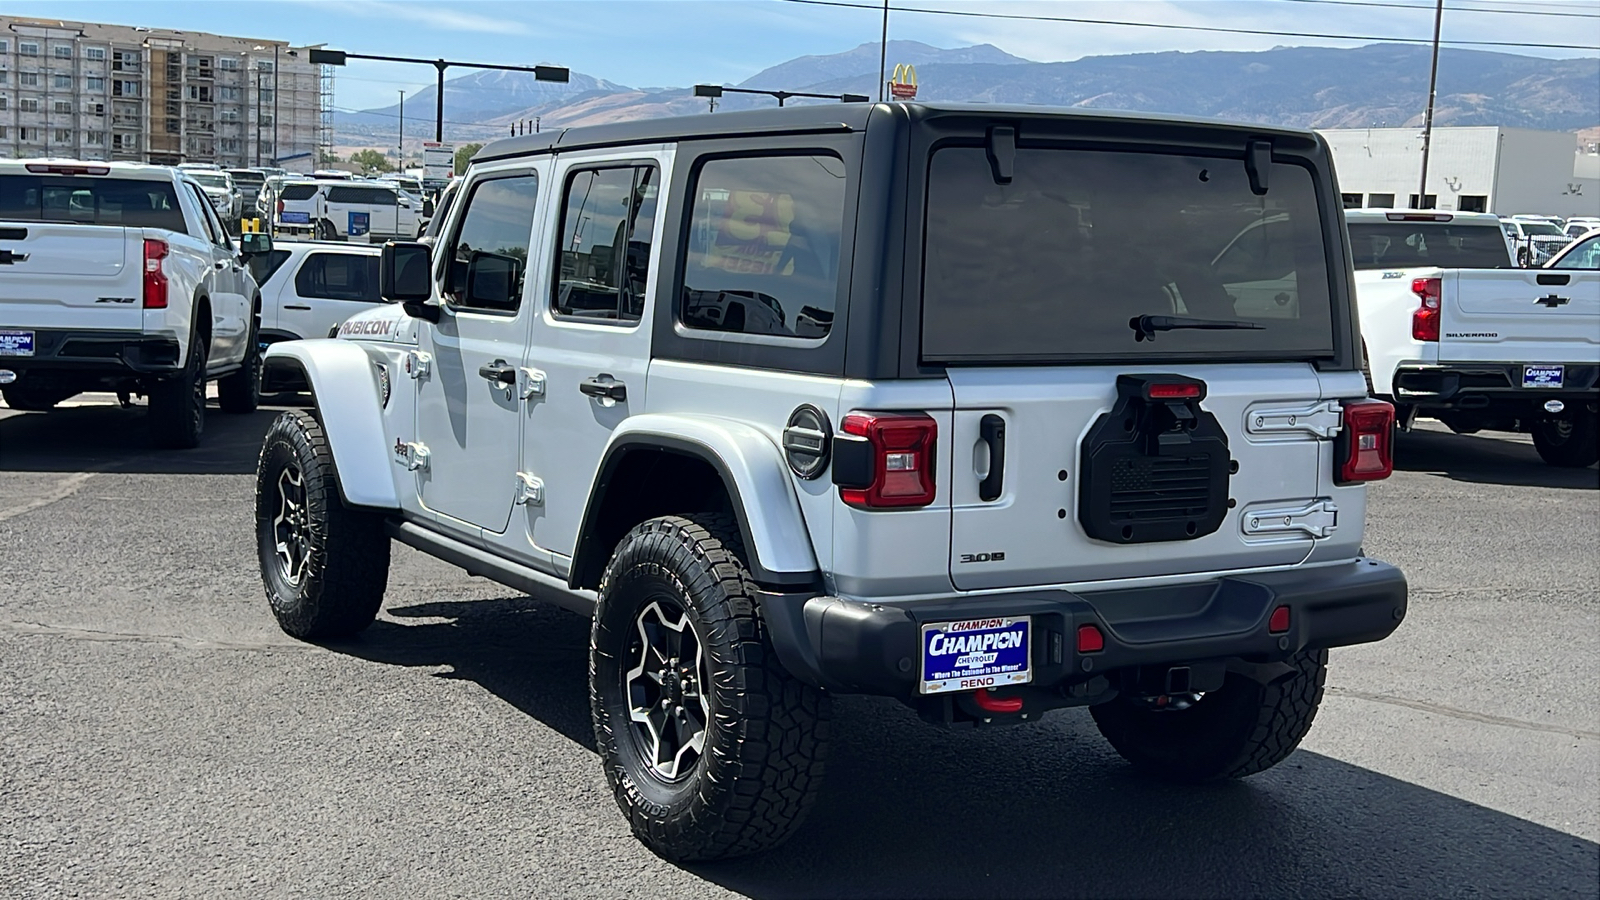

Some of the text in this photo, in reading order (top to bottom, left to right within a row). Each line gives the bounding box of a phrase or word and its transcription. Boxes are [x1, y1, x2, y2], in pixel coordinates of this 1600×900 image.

[340, 320, 392, 335] RUBICON
[1526, 368, 1561, 377] CHAMPION
[952, 619, 1003, 631] CHAMPION
[929, 631, 1023, 656] CHAMPION
[957, 654, 995, 665] CHEVROLET
[961, 667, 986, 676] Customer
[991, 665, 1001, 673] The
[960, 677, 995, 689] RENO
